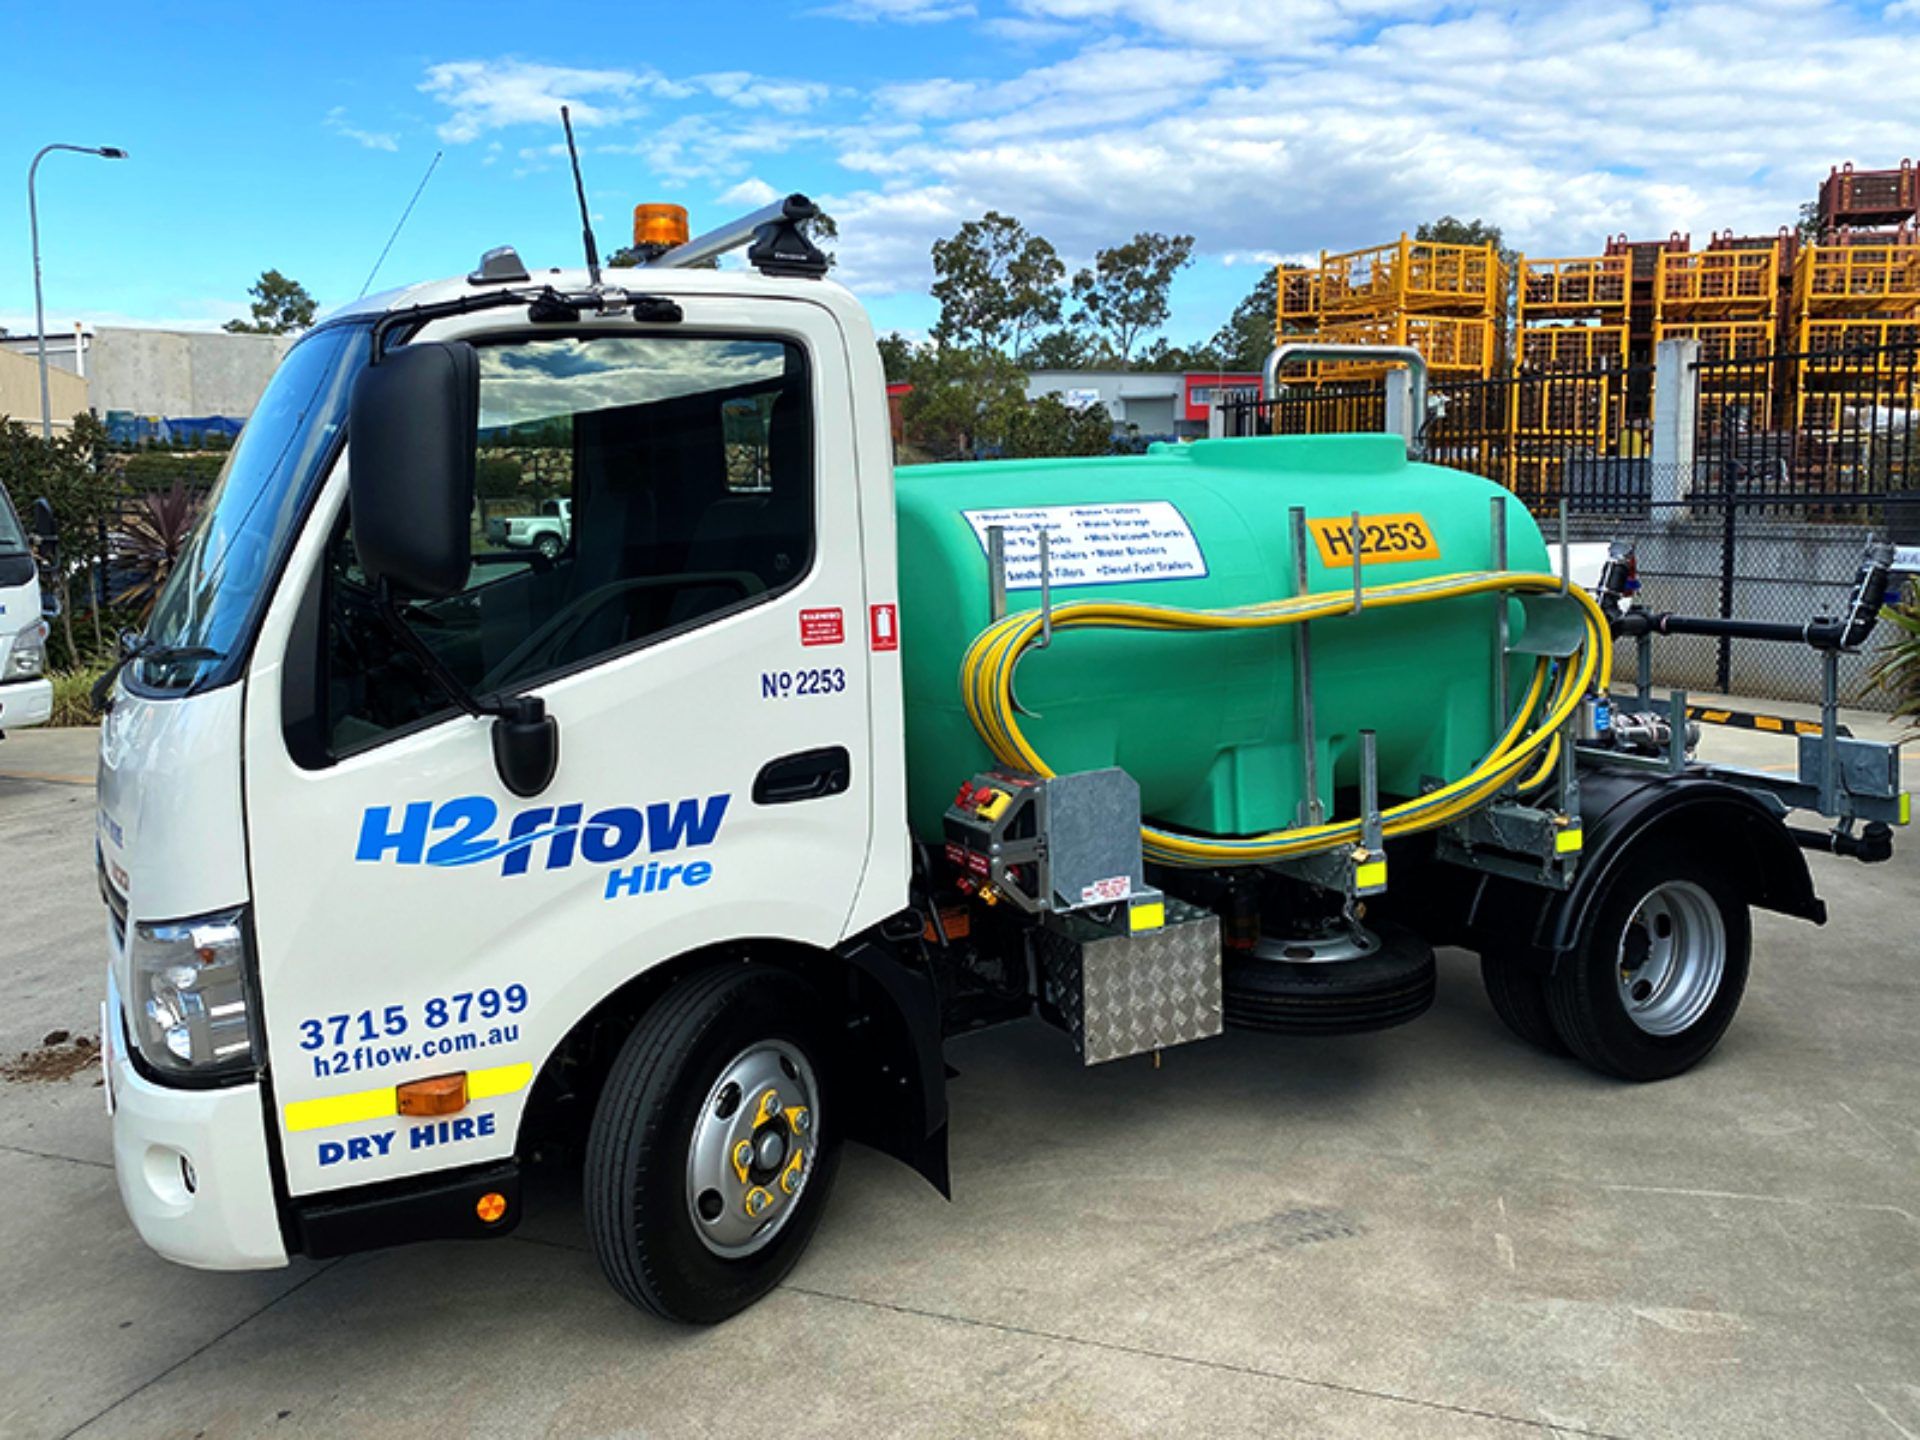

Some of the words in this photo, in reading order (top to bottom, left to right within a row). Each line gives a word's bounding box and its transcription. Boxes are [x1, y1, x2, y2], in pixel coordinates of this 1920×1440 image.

[1321, 521, 1428, 556] H2253
[796, 666, 846, 695] 2253
[603, 860, 713, 900] Hire
[299, 1004, 408, 1050] 3715
[424, 983, 529, 1029] 8799
[313, 1024, 520, 1078] h2flow.com.au
[318, 1130, 397, 1166] DRY
[410, 1112, 496, 1150] HIRE
